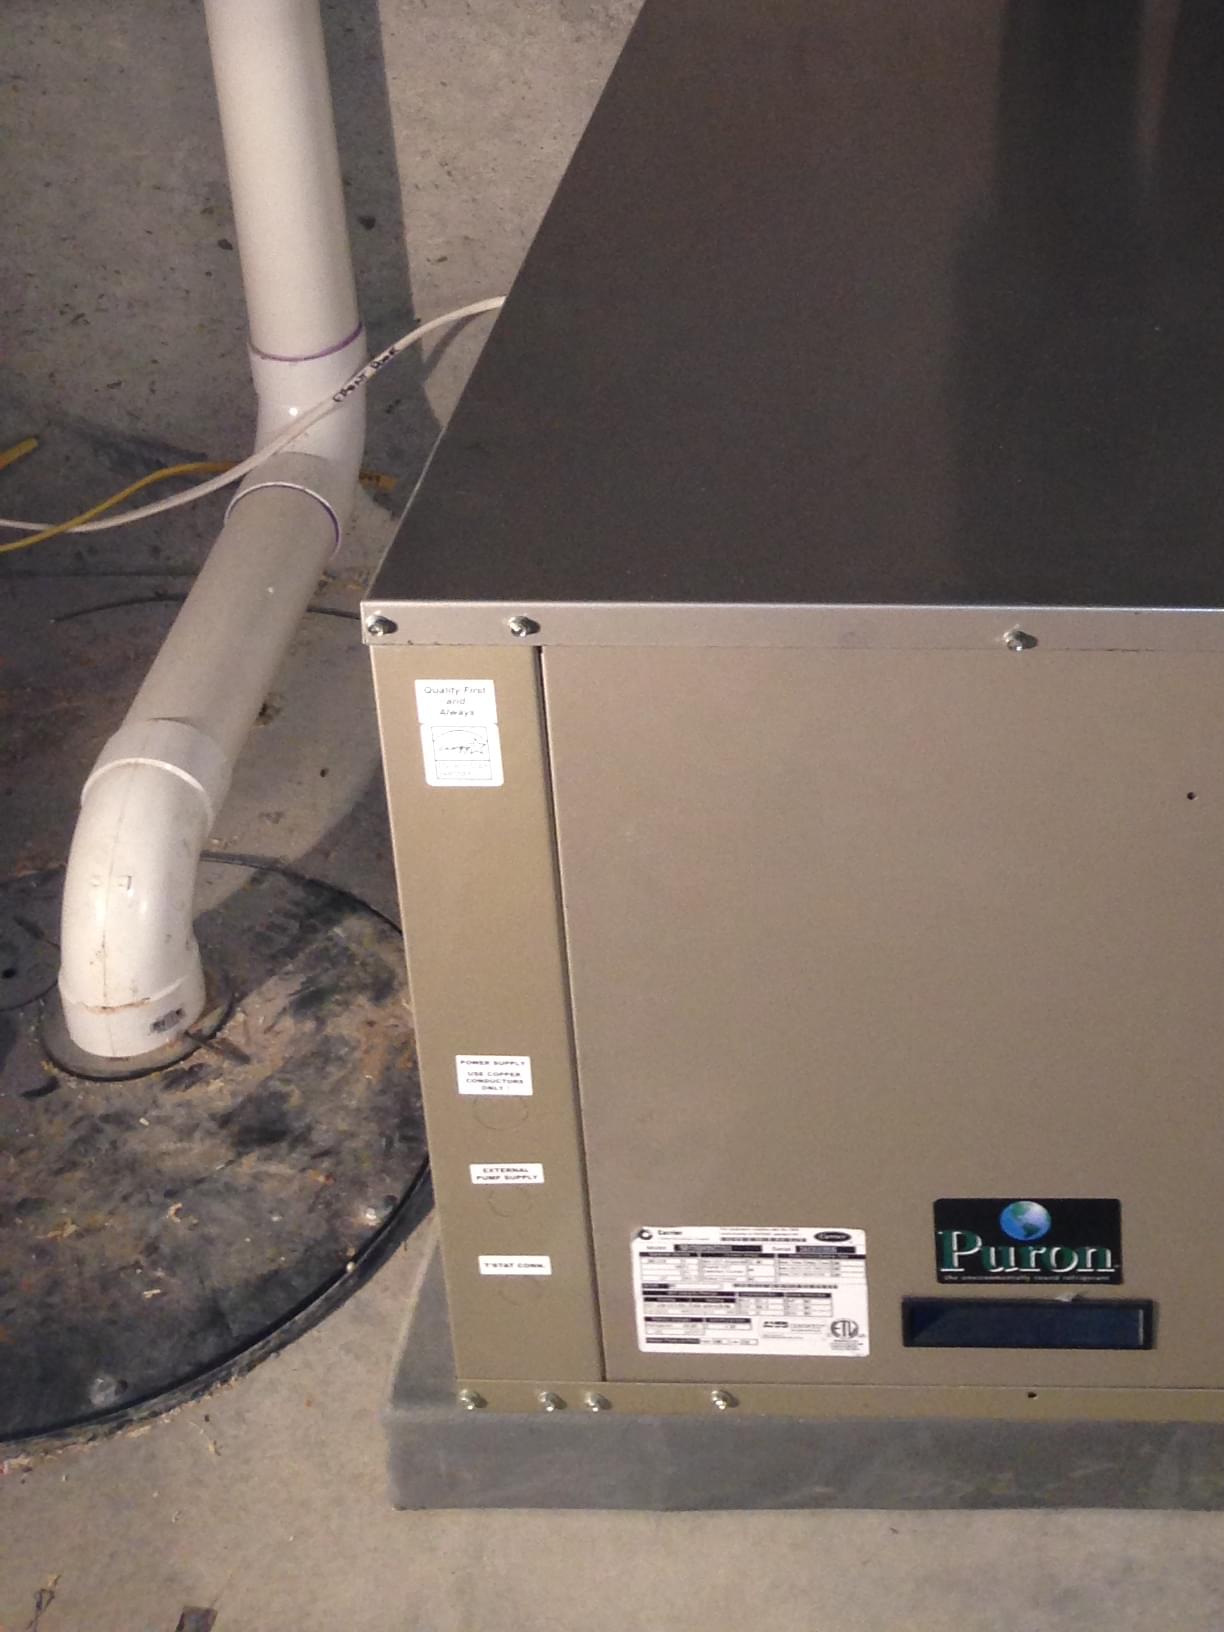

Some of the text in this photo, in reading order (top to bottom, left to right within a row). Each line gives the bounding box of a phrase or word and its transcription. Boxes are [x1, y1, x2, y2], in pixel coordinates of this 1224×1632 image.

[424, 686, 486, 696] Quality First
[439, 708, 475, 717] Always
[938, 1230, 1115, 1273] Puron
